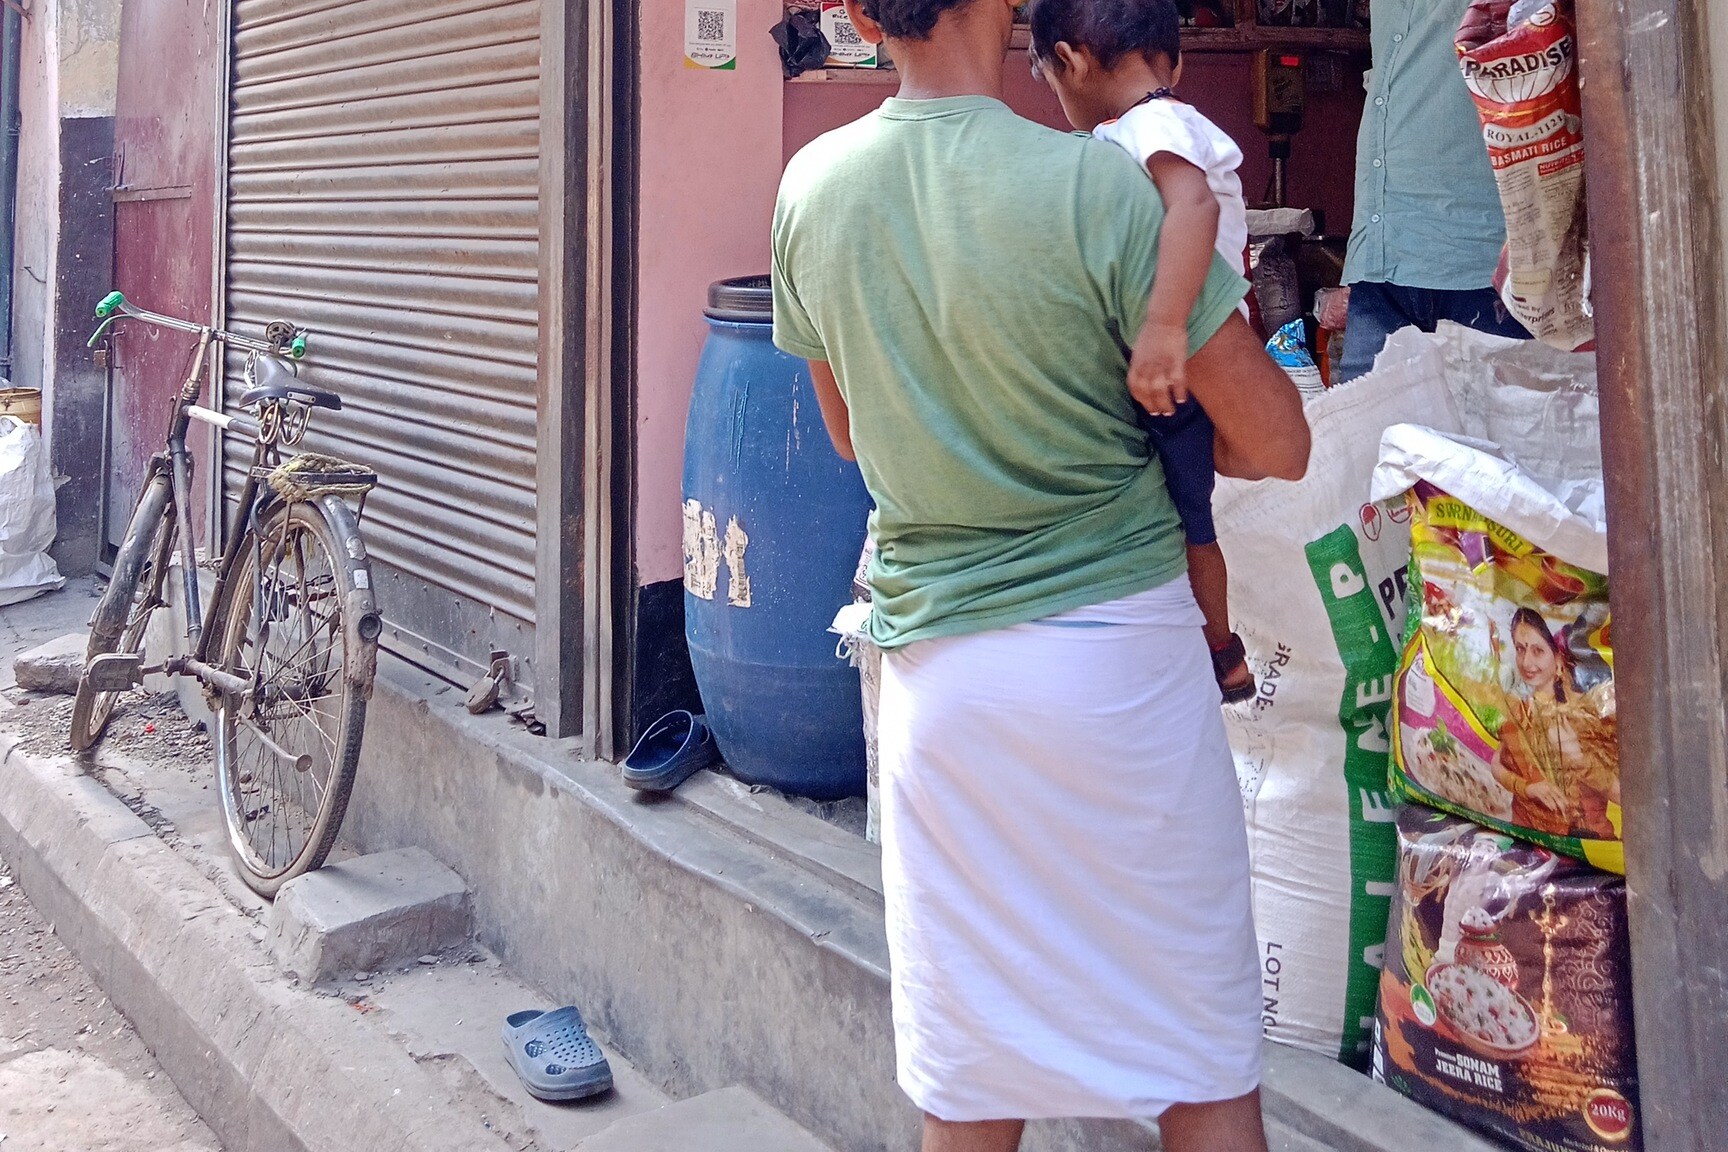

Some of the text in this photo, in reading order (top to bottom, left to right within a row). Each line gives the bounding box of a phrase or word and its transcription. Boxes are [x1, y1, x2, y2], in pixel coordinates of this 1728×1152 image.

[1464, 36, 1574, 79] PARADISE
[1486, 115, 1565, 143] ROYAL-1121
[1490, 136, 1567, 167] BASMATI RICE
[1263, 941, 1283, 992] LOT
[1436, 1058, 1503, 1093] JEERA RICE
[1456, 1053, 1500, 1079] SONAM
[1590, 1102, 1627, 1123] 20Kg
